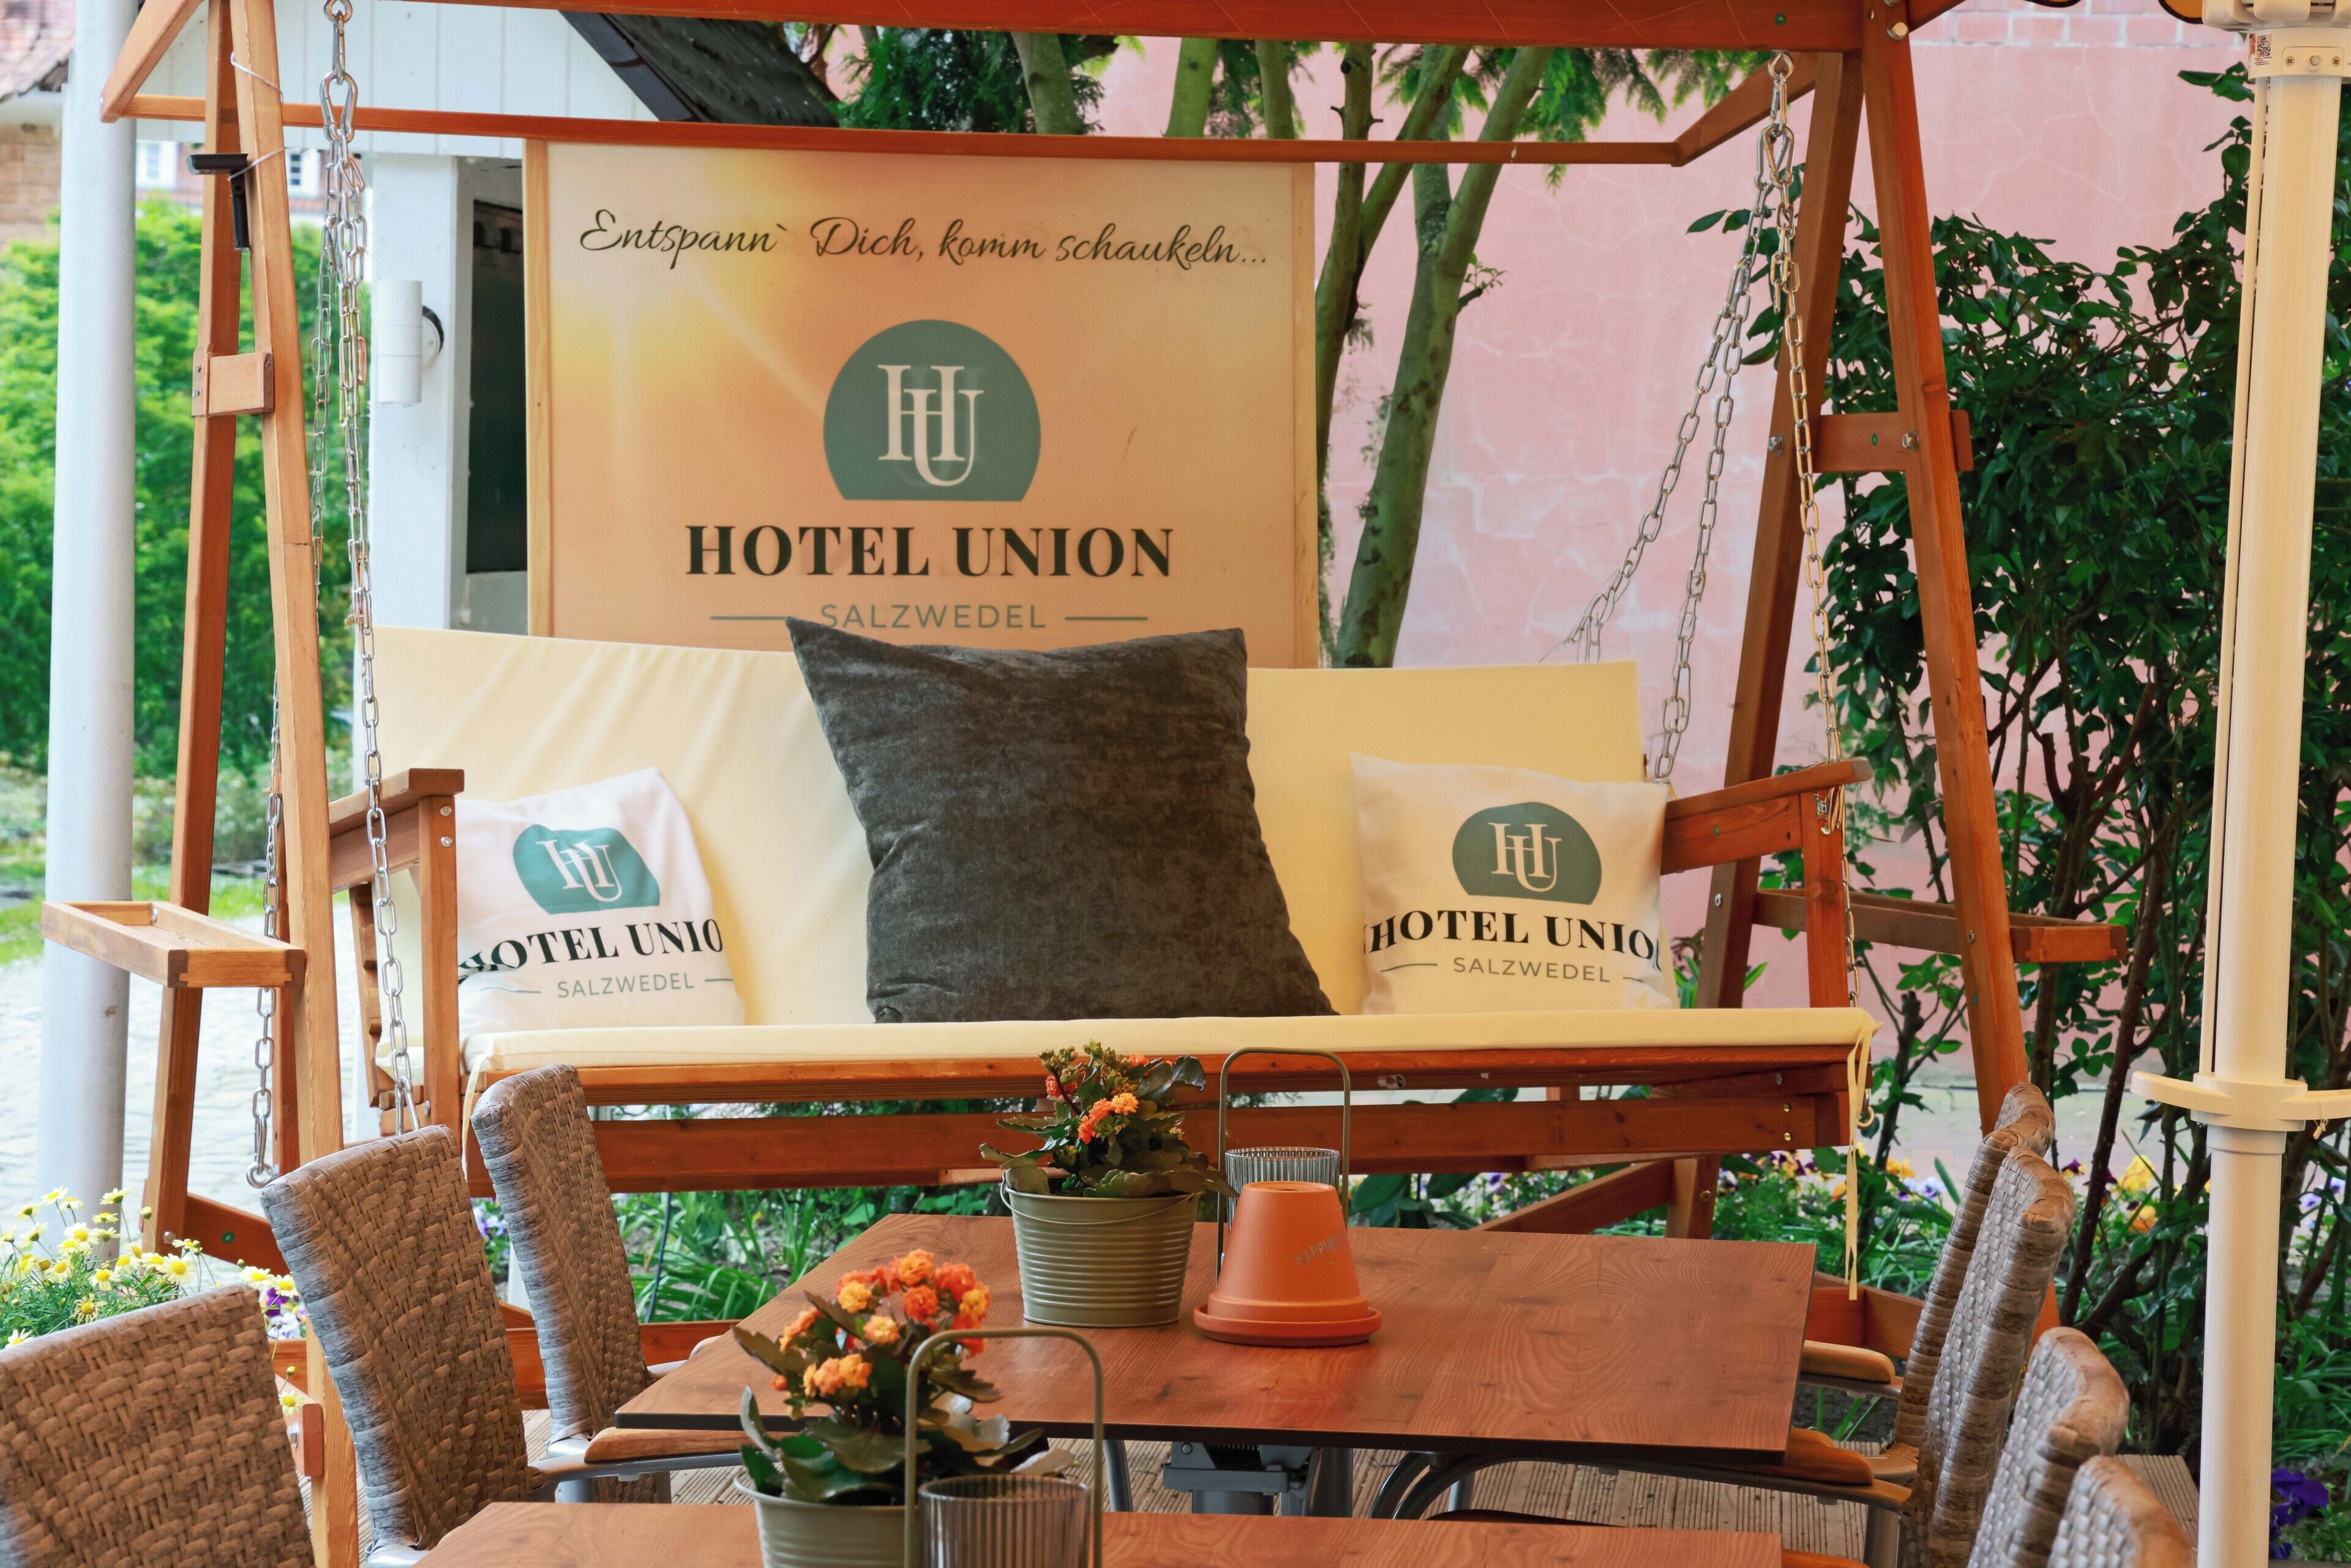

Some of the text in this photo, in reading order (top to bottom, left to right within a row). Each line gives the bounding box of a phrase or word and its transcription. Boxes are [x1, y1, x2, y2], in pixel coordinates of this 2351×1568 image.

[810, 216, 924, 263] Dich,
[939, 219, 1047, 266] komm
[685, 524, 1174, 577] HOTEL UNION
[820, 604, 1046, 628] SALZWEDEL
[1368, 910, 1662, 972] HOTEL UNIO
[557, 972, 695, 999] SALZWEDEL
[1453, 956, 1610, 983] SALZWEDEL
